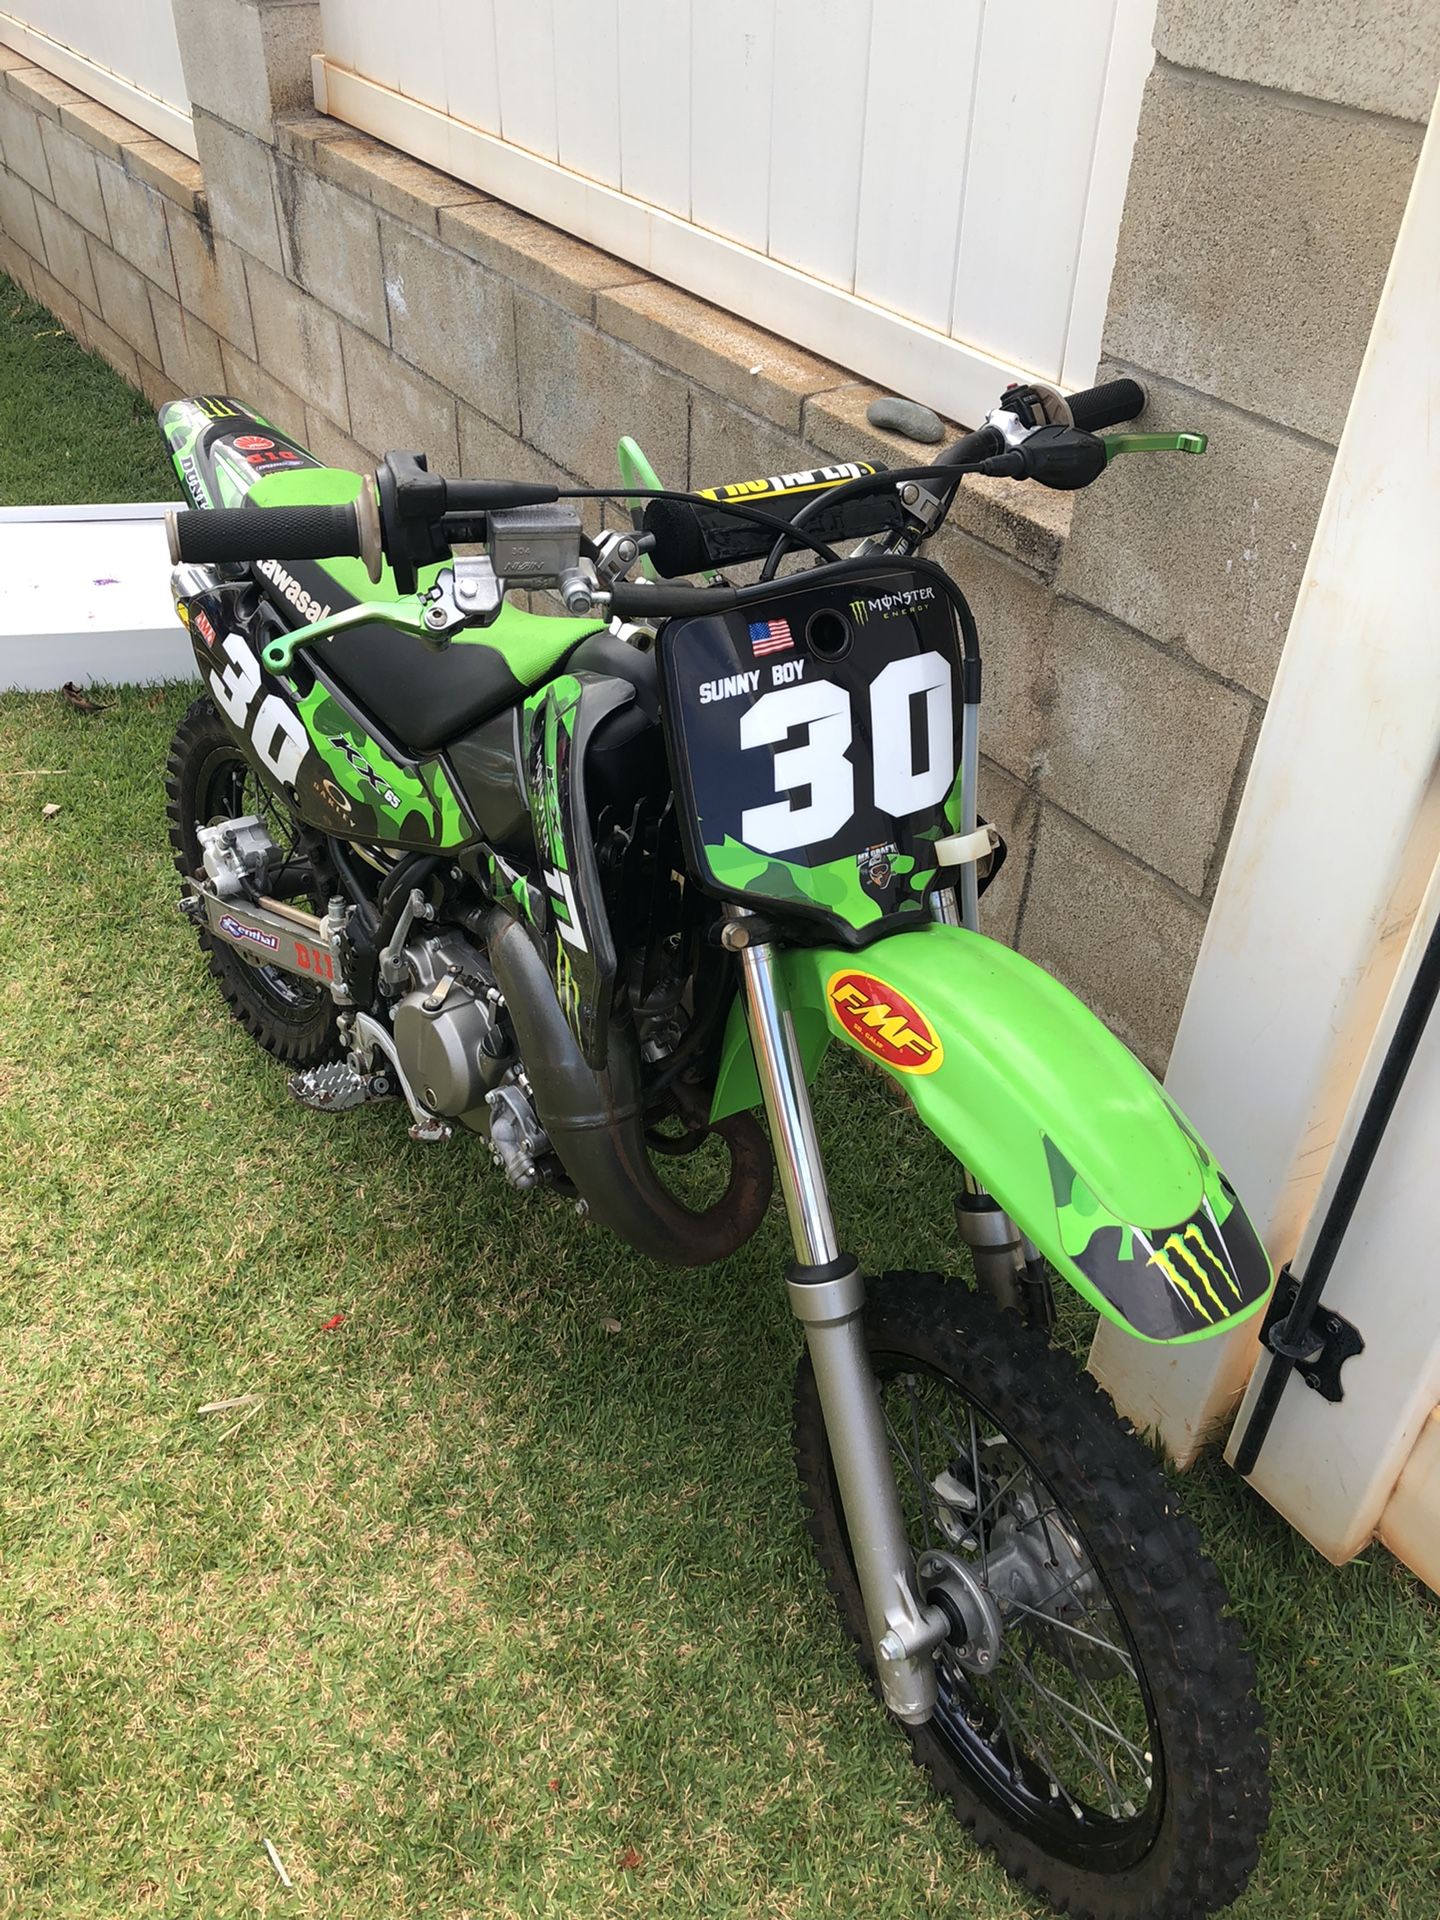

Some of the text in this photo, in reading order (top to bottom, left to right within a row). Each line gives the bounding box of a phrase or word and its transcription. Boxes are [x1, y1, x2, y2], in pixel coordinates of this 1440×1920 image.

[180, 454, 209, 510] DUNL
[868, 587, 935, 612] MONSTER
[883, 604, 929, 620] ENERGY
[209, 633, 310, 785] 30
[699, 659, 804, 704] SUNNY BOY
[328, 734, 402, 809] KX 65
[739, 650, 954, 854] 30
[313, 781, 356, 828] OAKLEY
[831, 982, 938, 1056] FMF
